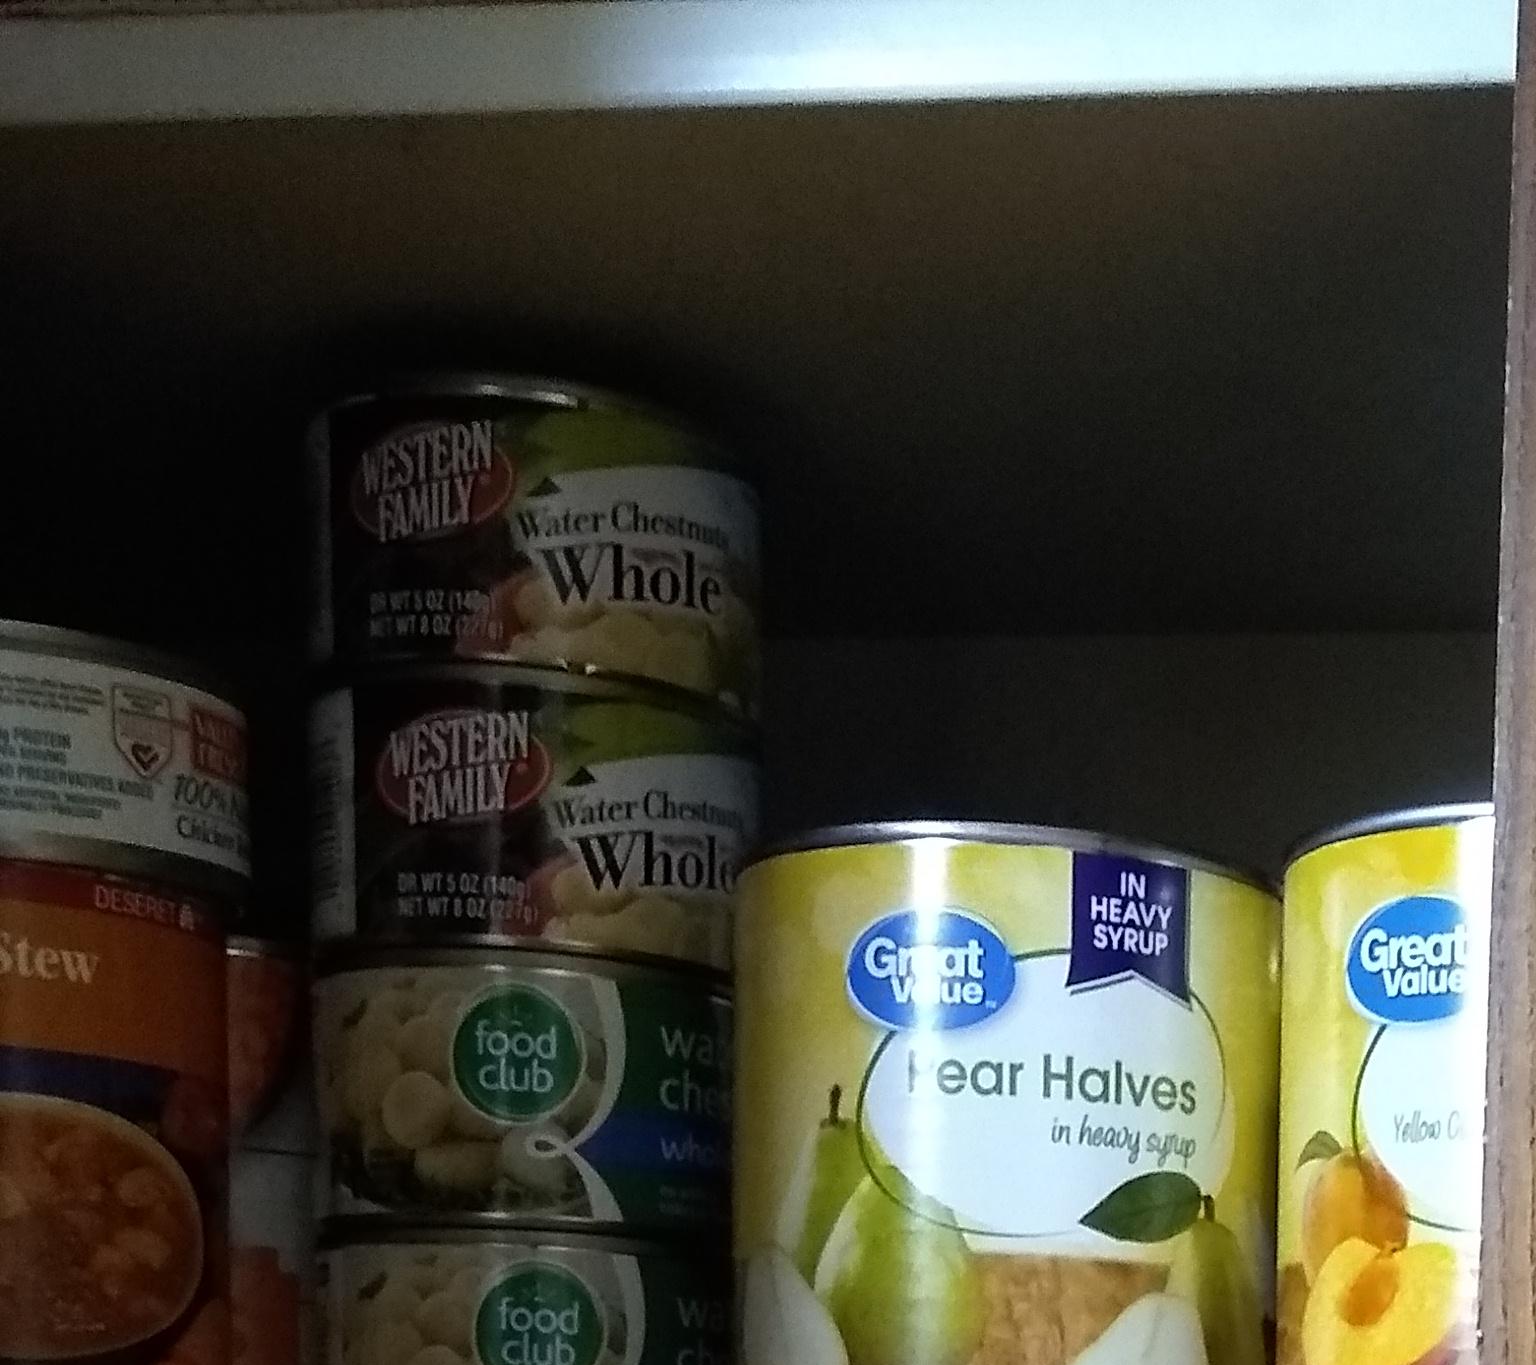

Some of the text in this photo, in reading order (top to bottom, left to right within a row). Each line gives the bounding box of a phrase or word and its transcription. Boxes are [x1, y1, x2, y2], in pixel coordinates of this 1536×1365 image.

[361, 419, 494, 495] WESTERN
[378, 473, 477, 543] FAMILY
[517, 508, 605, 540] Water
[541, 541, 724, 615] Whole
[390, 710, 529, 780] WESTERN
[408, 762, 510, 826] FAMILY
[555, 798, 638, 829] Water
[421, 871, 443, 893] WT
[446, 872, 457, 894] 5
[459, 872, 480, 894] OZ
[576, 830, 738, 894] Whole
[95, 884, 178, 924] DESERET
[1119, 871, 1147, 900] IN
[398, 896, 422, 917] NET
[427, 896, 450, 918] WT
[466, 896, 487, 919] OZ
[1090, 895, 1173, 930] HEAVY
[864, 936, 985, 980] Grat
[1093, 924, 1169, 957] SYRUP
[1360, 924, 1468, 973] Great
[890, 975, 985, 1006] Vue
[1383, 964, 1467, 998] Value
[474, 1019, 559, 1061] food
[478, 1059, 554, 1094] club
[1041, 1053, 1197, 1115] Halves
[1051, 1114, 1197, 1168] in heavy syrup
[1394, 1109, 1441, 1143] Yellow
[498, 1296, 580, 1338] food
